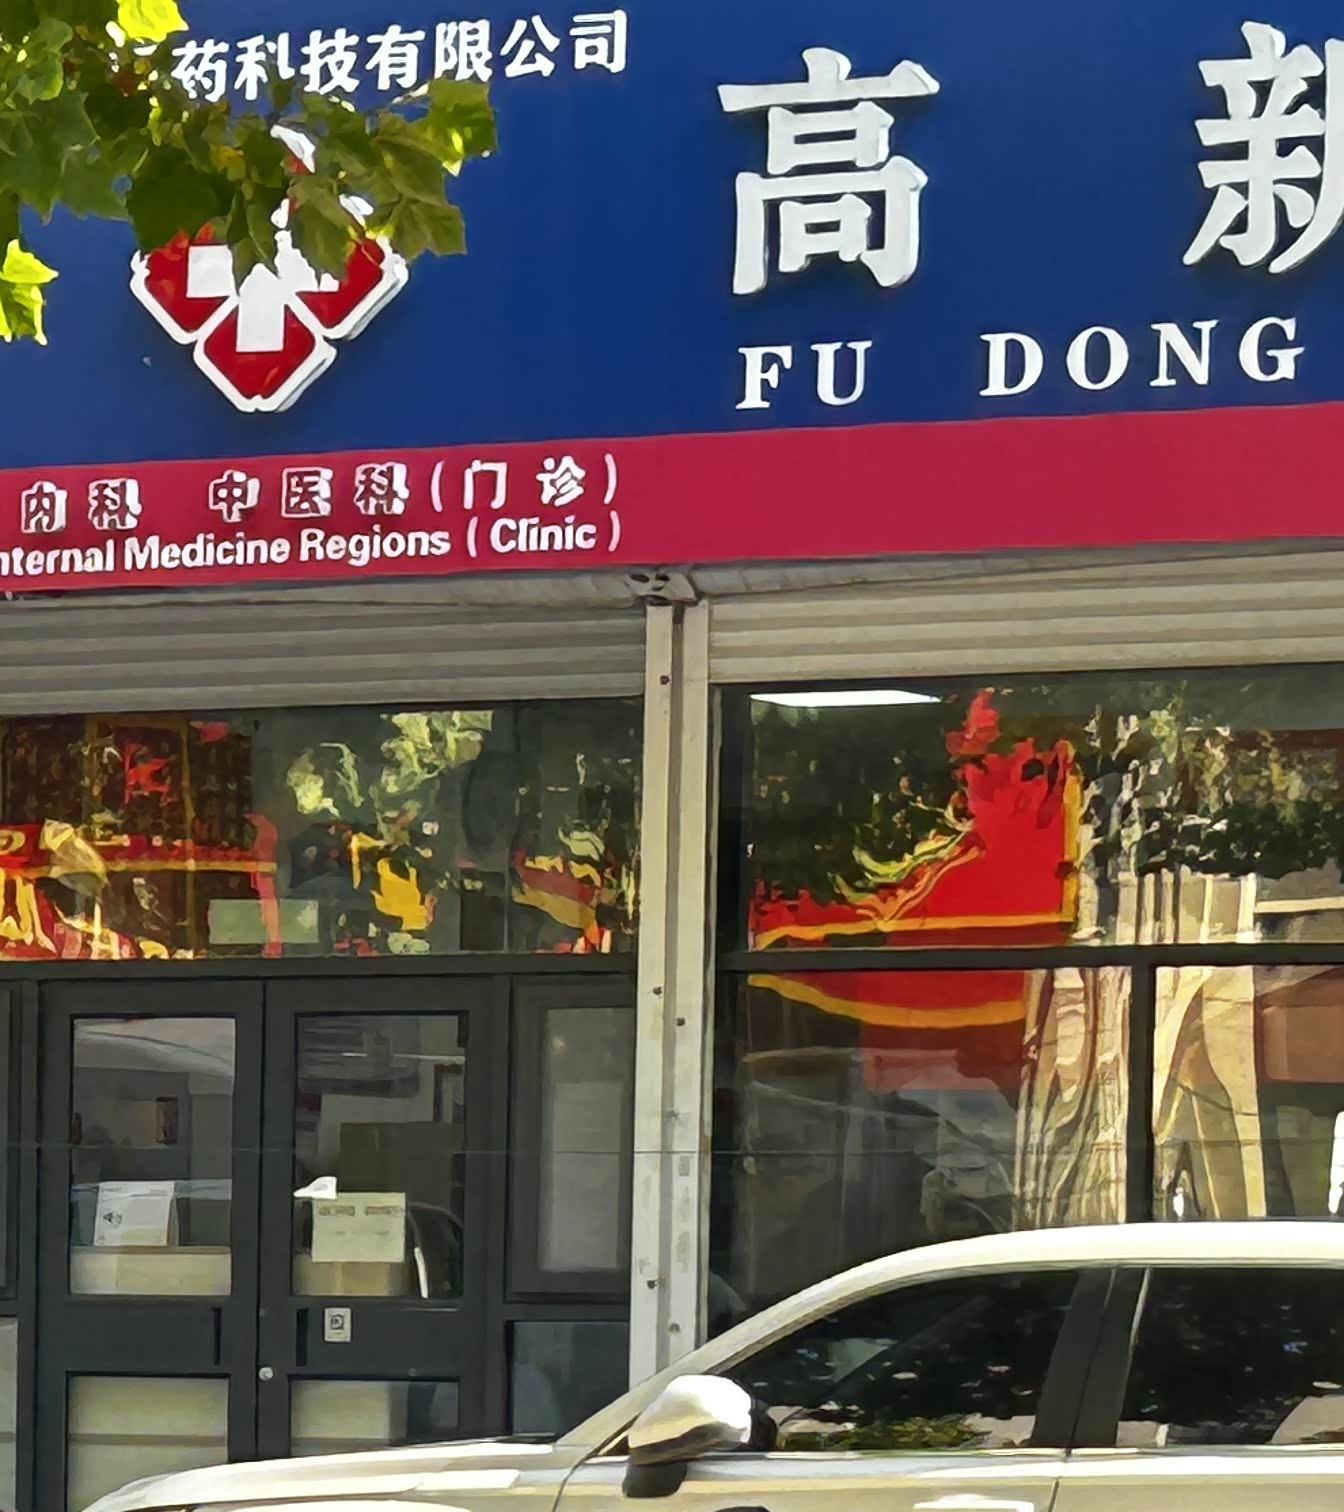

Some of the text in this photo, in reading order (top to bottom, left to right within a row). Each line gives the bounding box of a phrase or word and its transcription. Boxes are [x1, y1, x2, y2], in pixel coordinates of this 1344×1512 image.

[134, 9, 629, 102] 药科技有限公司
[735, 315, 1305, 410] FU DONG
[124, 530, 291, 571] Medicine
[299, 523, 452, 568] Regions
